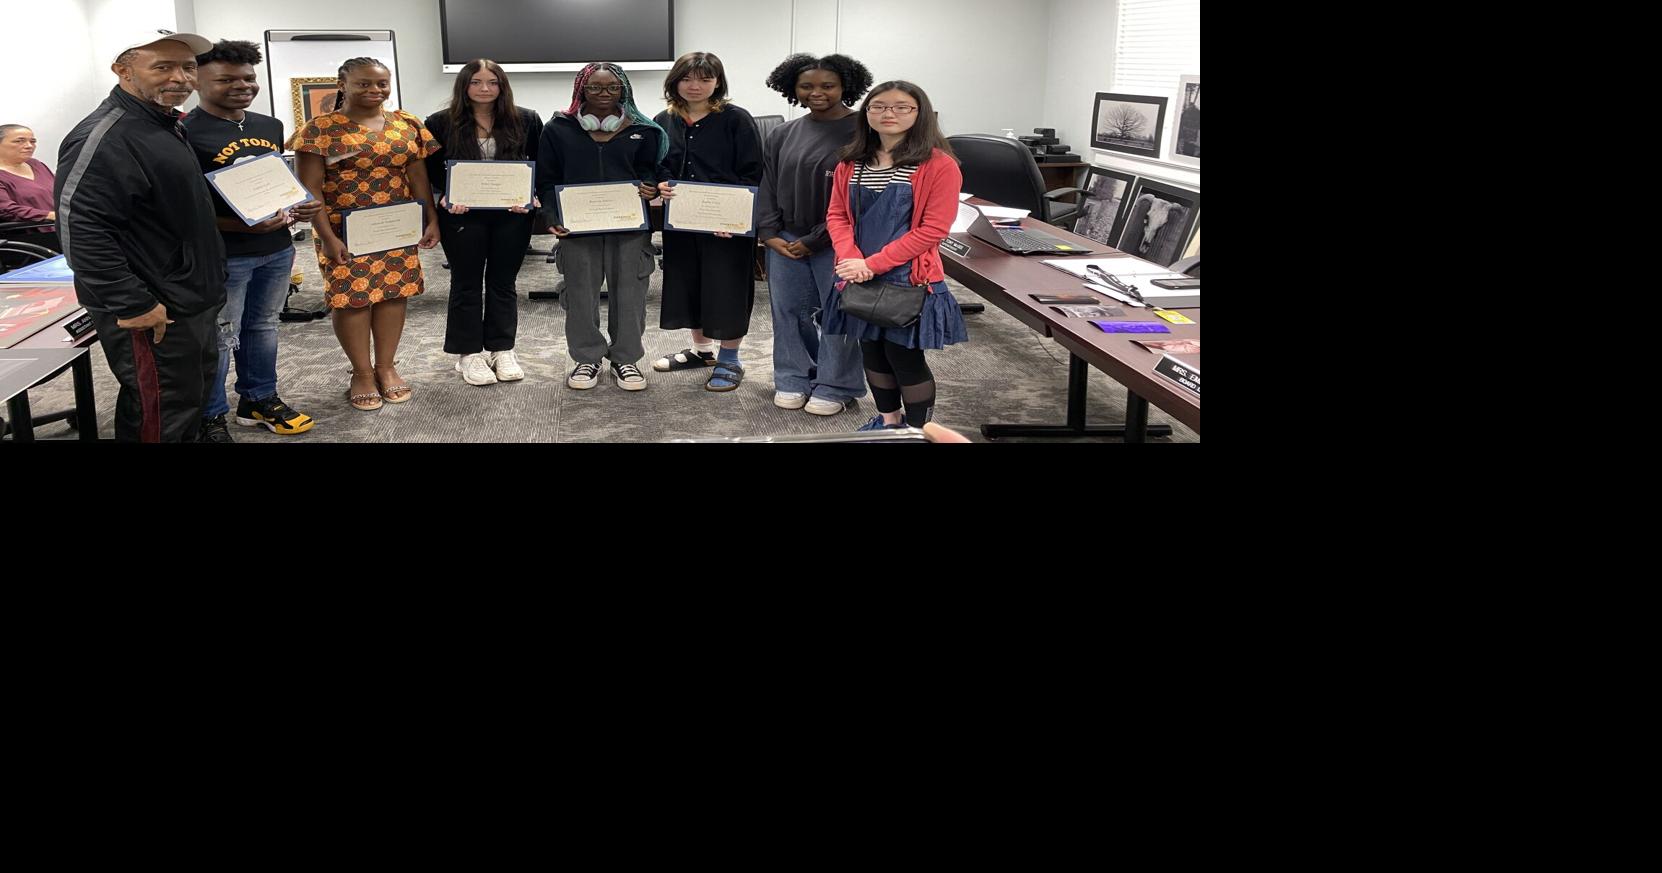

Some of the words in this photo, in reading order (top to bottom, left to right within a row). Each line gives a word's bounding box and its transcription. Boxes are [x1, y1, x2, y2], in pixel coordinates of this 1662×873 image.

[212, 142, 241, 164] NOT
[240, 138, 280, 152] TODA
[1189, 374, 1200, 384] EM
